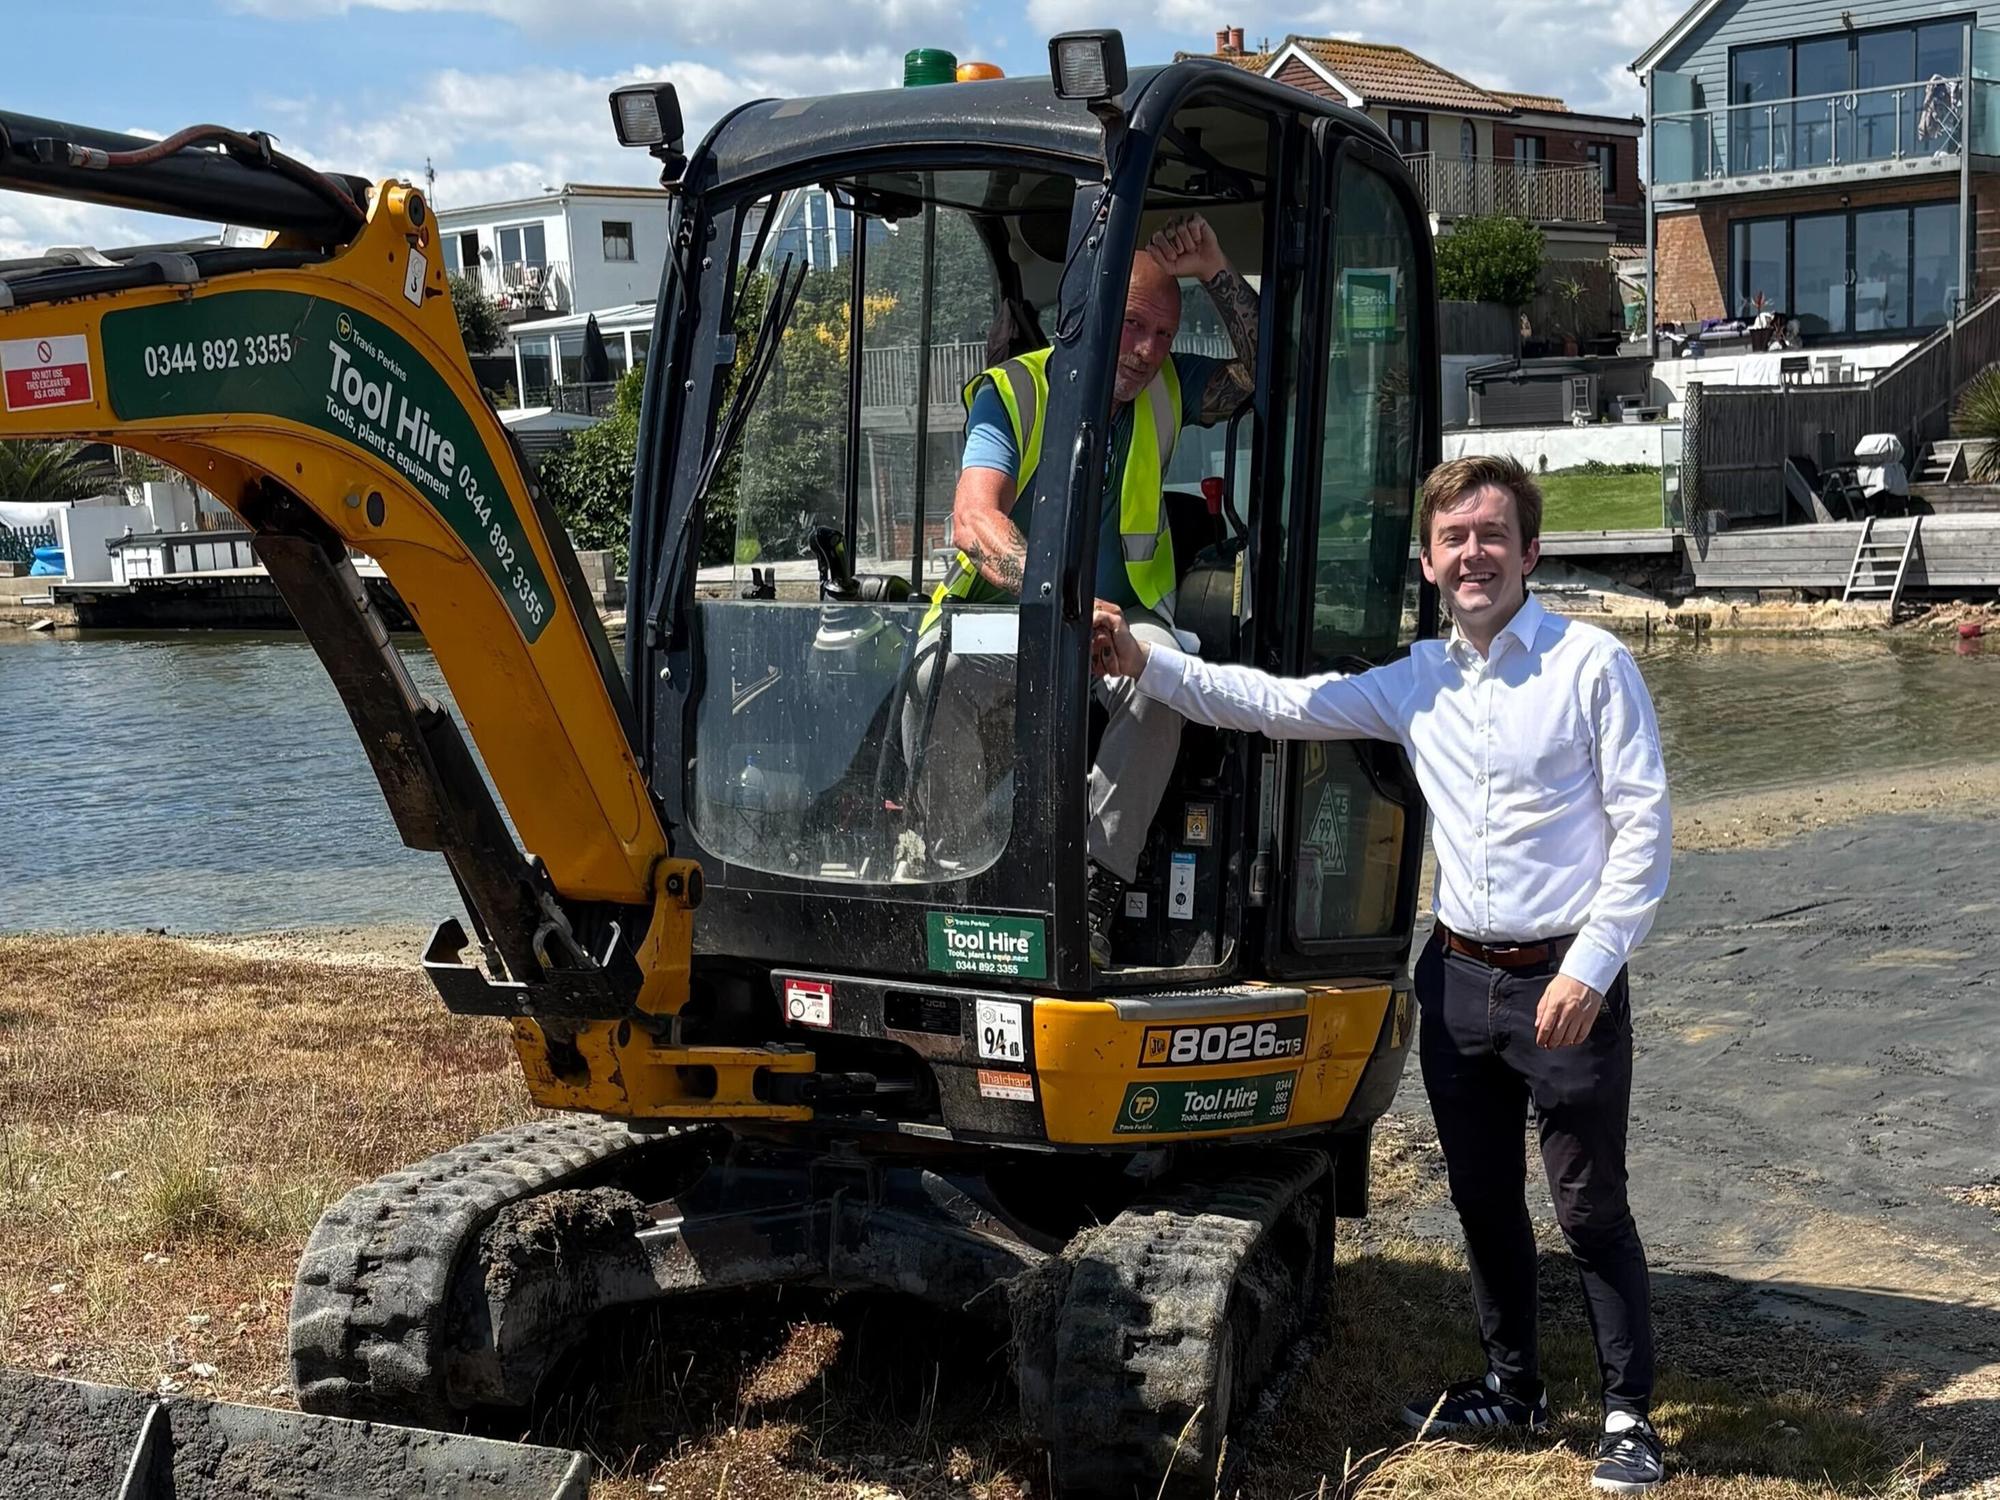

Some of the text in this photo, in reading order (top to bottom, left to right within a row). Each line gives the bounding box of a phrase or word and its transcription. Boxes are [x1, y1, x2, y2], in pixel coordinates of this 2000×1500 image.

[145, 333, 291, 377] 0344 892 3355
[353, 329, 407, 382] Travis Perkins
[32, 369, 63, 380] DO NOT USE
[26, 378, 71, 390] THIS EXCAVATOR
[34, 388, 66, 399] AS A CRANE
[329, 340, 455, 477] Tool Hire
[326, 395, 450, 499] Tools, plant & equipment
[459, 465, 544, 624] 0344 892 3355
[944, 929, 1028, 953] Tool Hire
[948, 949, 967, 958] Tools,
[968, 950, 985, 959] plant
[956, 961, 1018, 974] 0344 892 3355
[1001, 1013, 1006, 1022] L
[984, 1027, 1019, 1056] 94 dB
[1171, 1023, 1276, 1062] 8026
[1275, 1038, 1302, 1054] CTS
[1276, 1079, 1292, 1091] 0344
[1136, 1096, 1154, 1114] TP
[1184, 1087, 1258, 1112] Tool Hire
[1275, 1092, 1288, 1103] 892
[1200, 1113, 1217, 1122] plant
[1223, 1110, 1254, 1120] equipment
[1270, 1104, 1287, 1116] 3355
